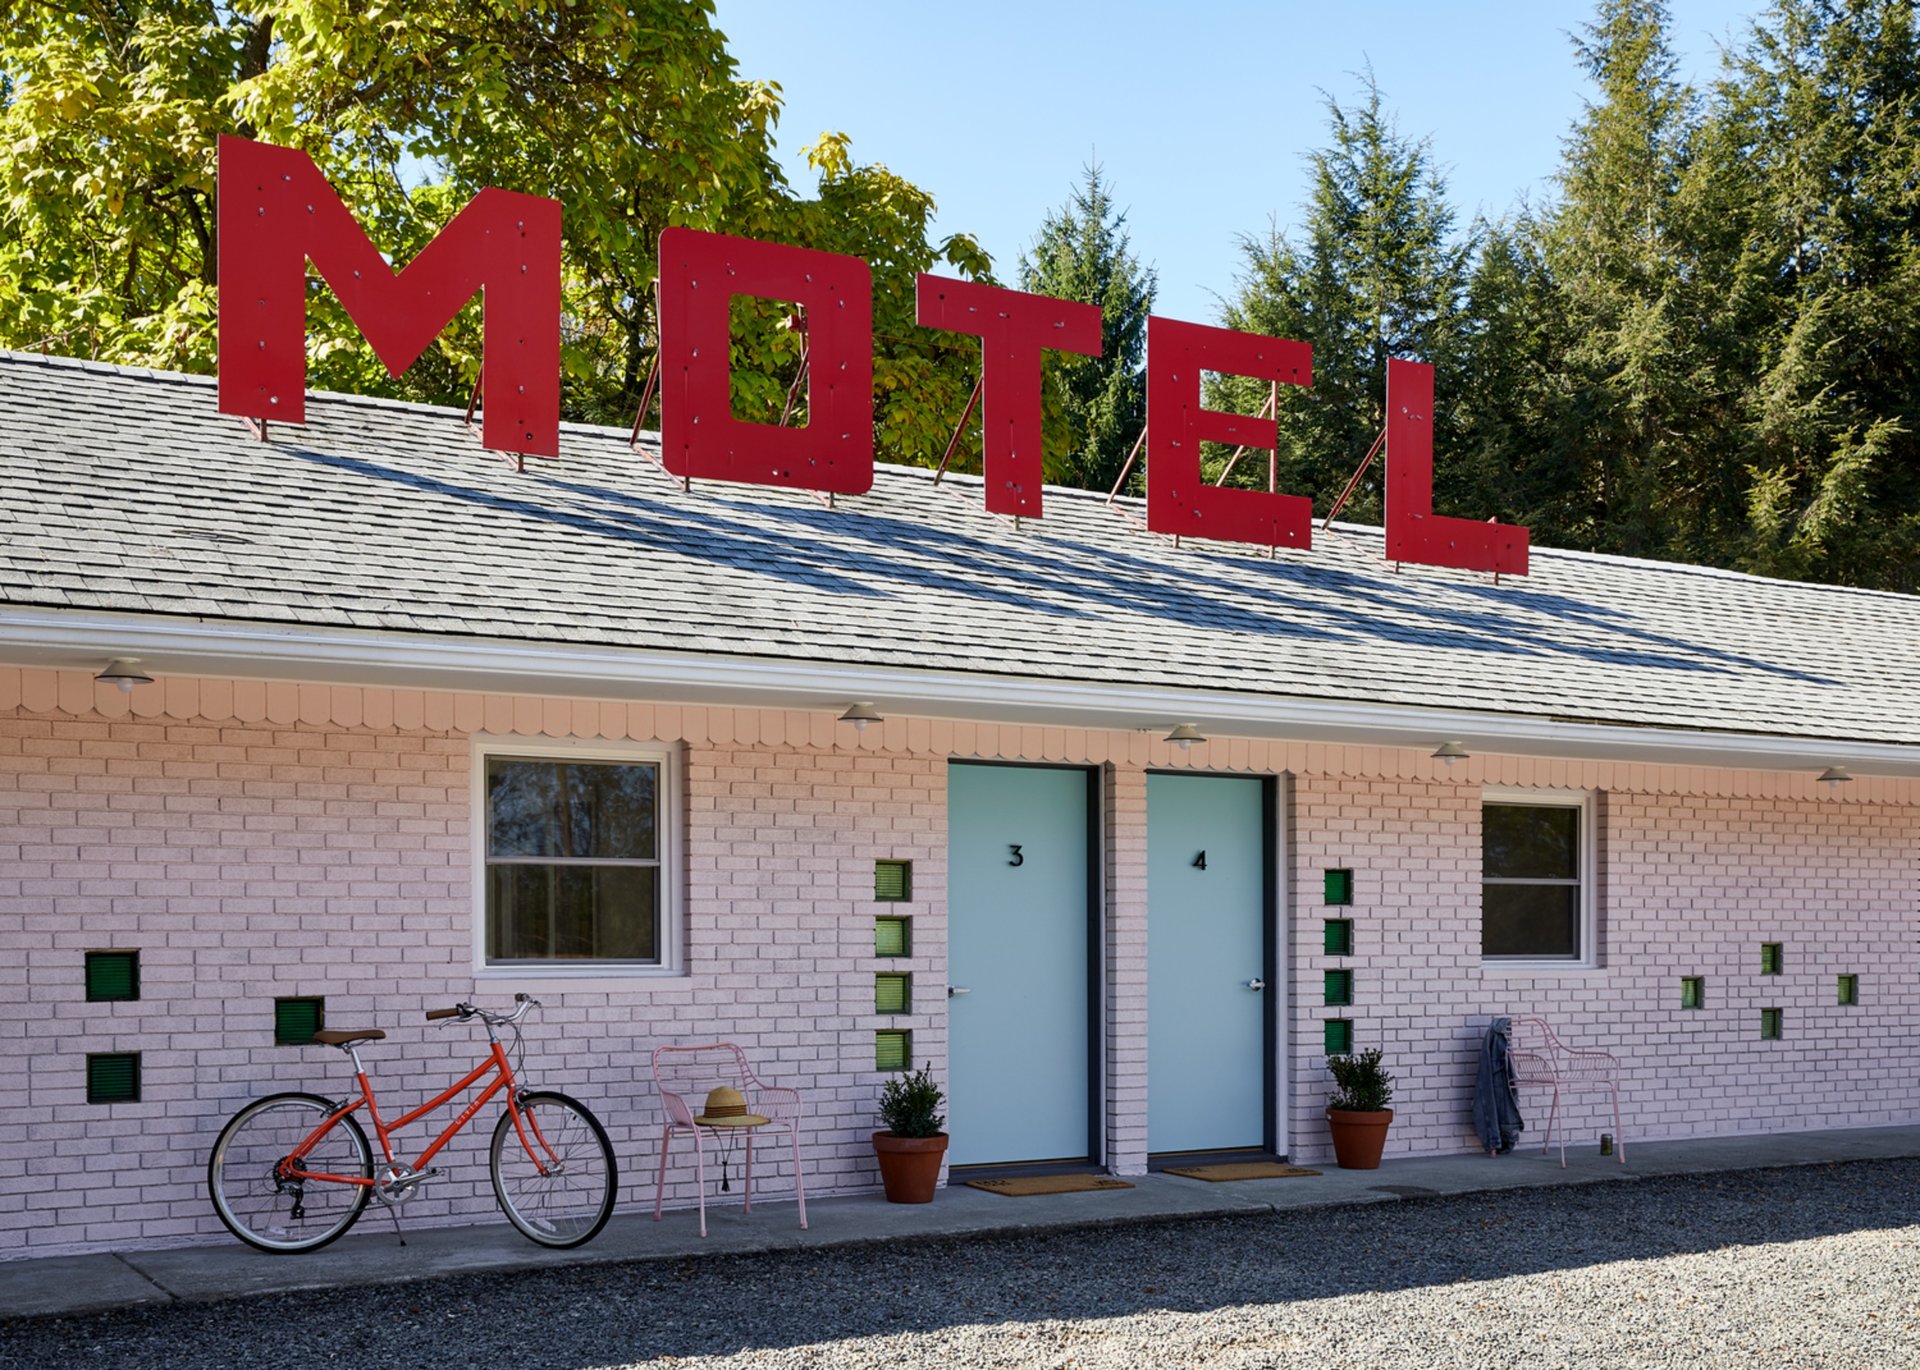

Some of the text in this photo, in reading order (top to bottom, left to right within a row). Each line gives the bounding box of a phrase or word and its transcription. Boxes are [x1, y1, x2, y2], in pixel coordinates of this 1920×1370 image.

[218, 134, 1530, 576] MOTEL
[1008, 844, 1024, 867] 3
[1191, 849, 1208, 871] 4
